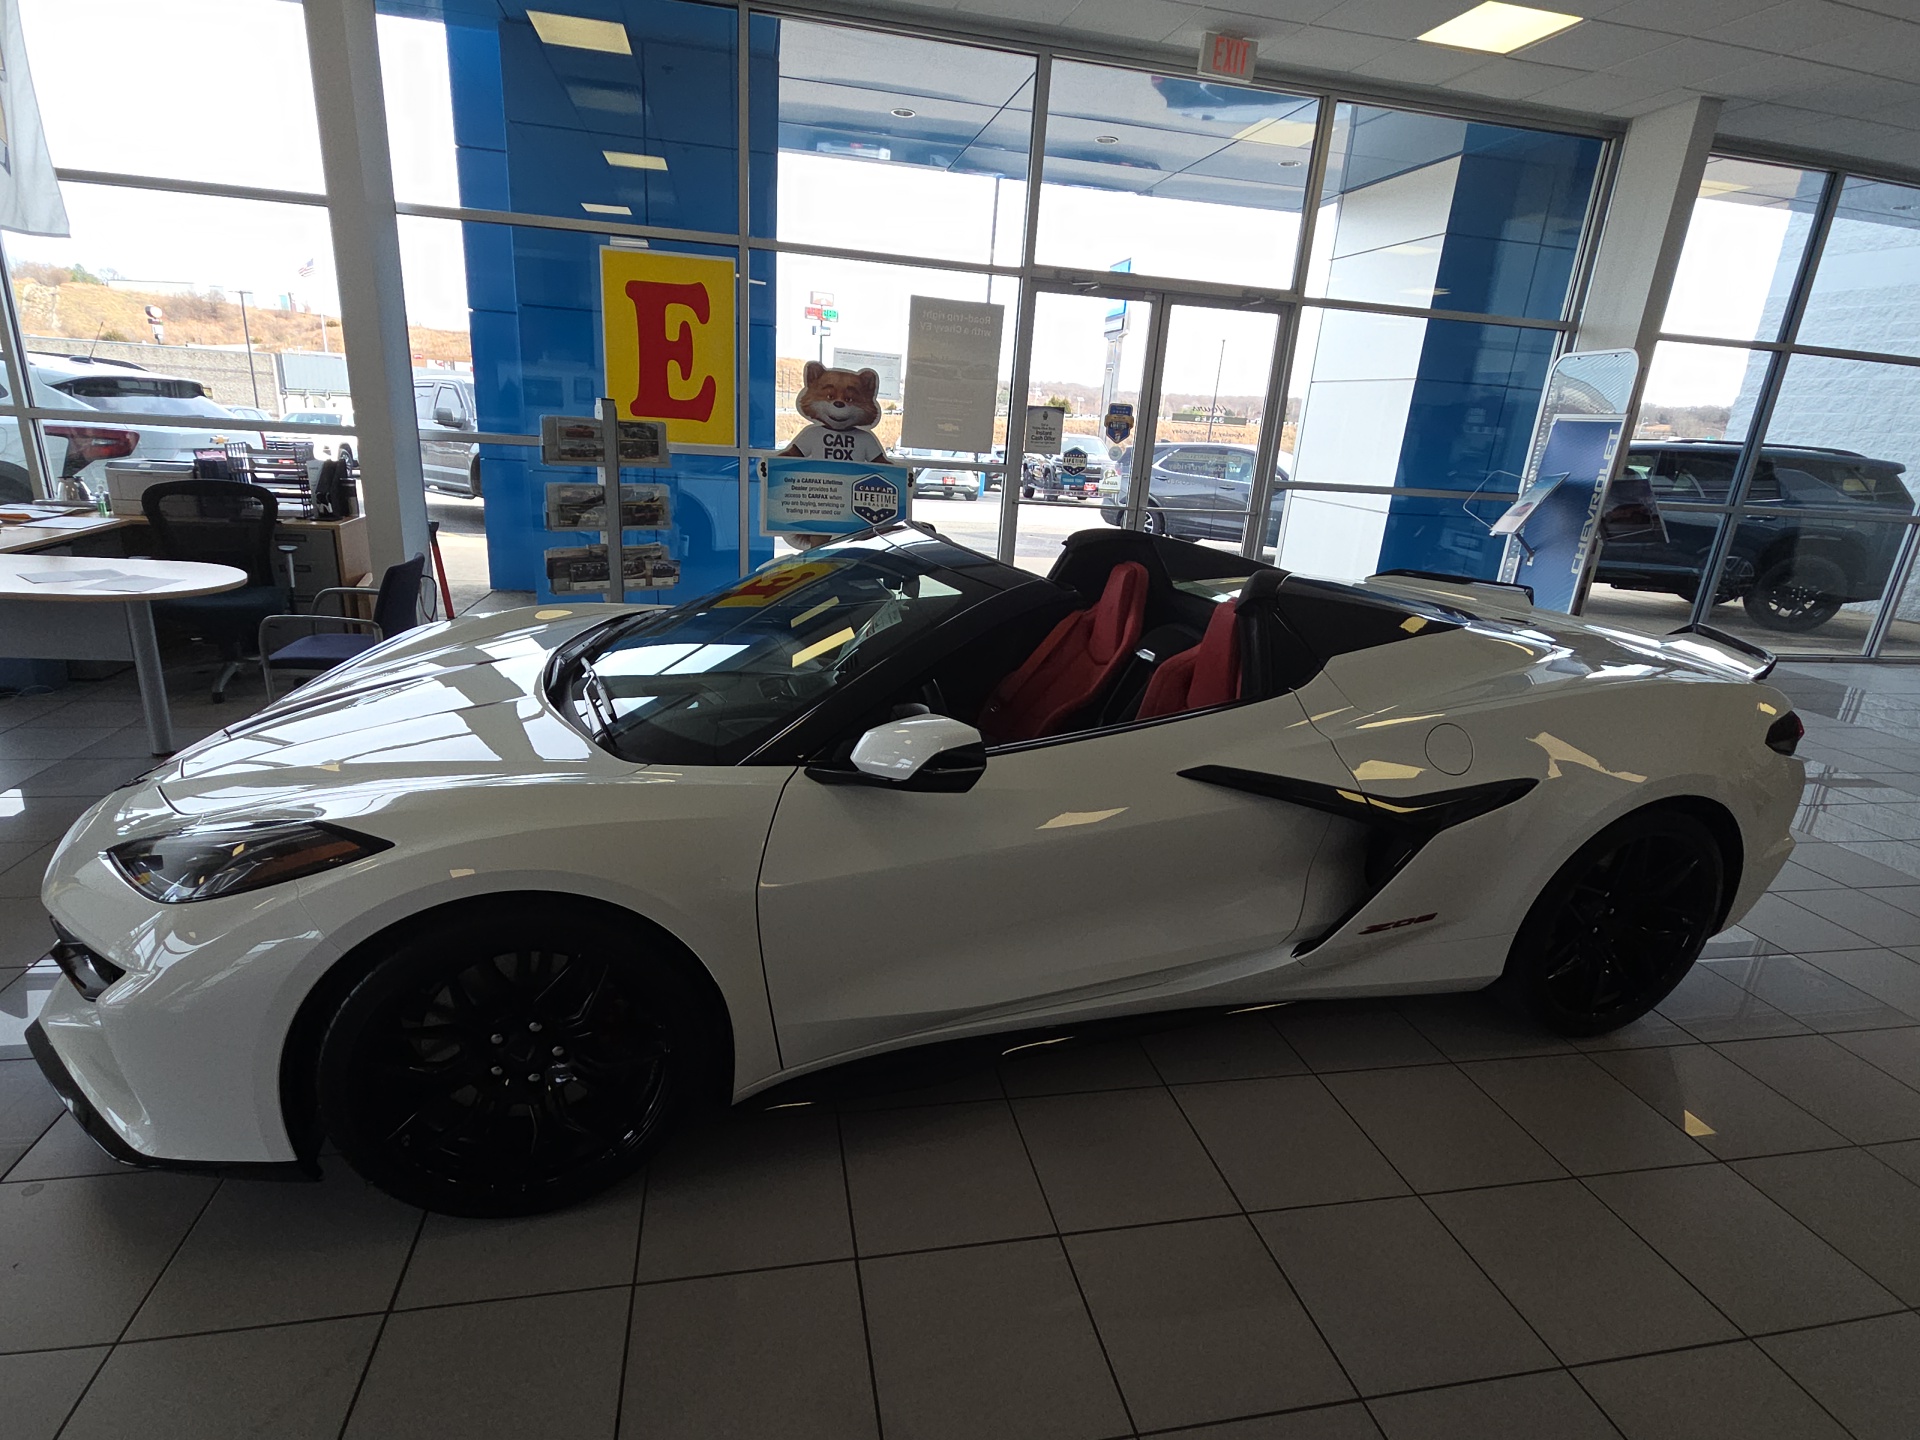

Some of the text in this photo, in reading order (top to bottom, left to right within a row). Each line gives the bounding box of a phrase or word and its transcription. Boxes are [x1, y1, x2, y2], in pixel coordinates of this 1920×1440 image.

[1212, 35, 1251, 75] EXIT
[625, 280, 716, 423] E
[823, 434, 854, 448] CAR
[824, 448, 854, 460] FOX
[854, 492, 896, 504] LIFETIME
[1570, 428, 1620, 575] CHEVROLET
